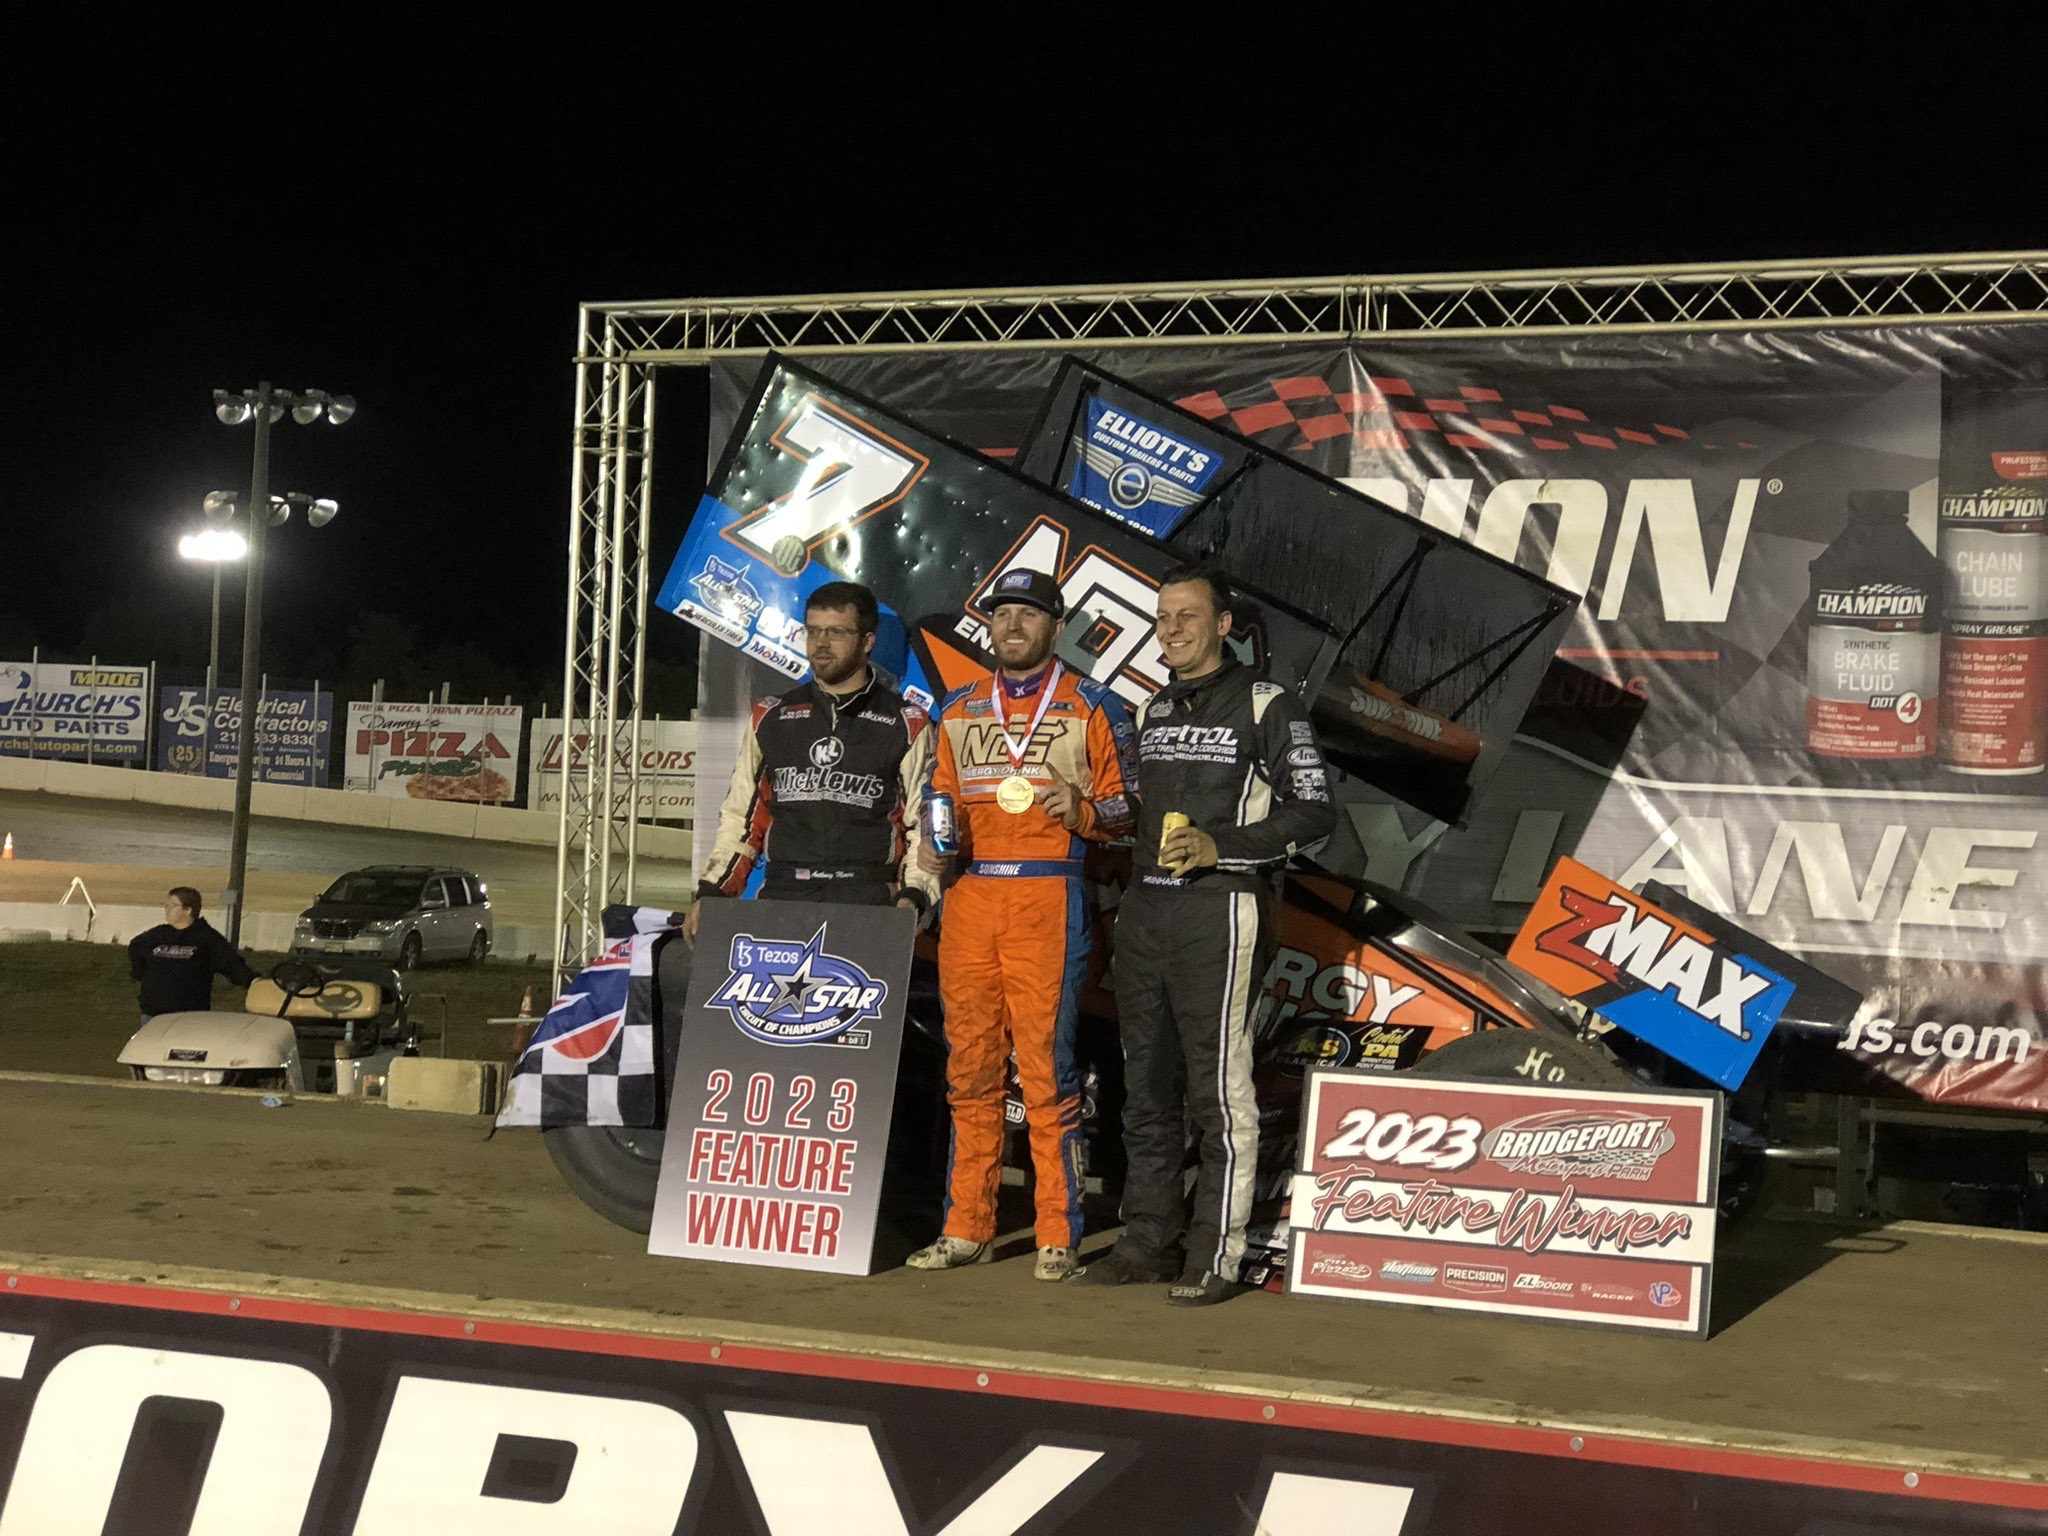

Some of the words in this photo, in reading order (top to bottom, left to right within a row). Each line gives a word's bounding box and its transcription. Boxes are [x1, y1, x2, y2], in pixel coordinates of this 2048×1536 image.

[1097, 410, 1210, 473] ELLIOTT'S
[1093, 431, 1126, 453] CUSTOM
[1123, 445, 1163, 469] TRAILERS
[1160, 463, 1168, 473] &
[1168, 465, 1197, 484] CARTS
[721, 392, 929, 574] 7
[1942, 498, 2047, 518] CHAMPION
[1337, 478, 1761, 622] ON
[1956, 552, 2022, 573] CHAIN
[1960, 577, 2016, 597] LUBE
[1817, 593, 1926, 615] CHAMPION
[953, 614, 997, 656] EN
[1984, 624, 2024, 635] GREASE
[750, 641, 787, 667] Mobil
[1843, 639, 1890, 650] SYNTHETIC
[1834, 652, 1900, 671] BRAKE
[73, 671, 142, 687] MOOG
[1837, 673, 1894, 692] FLUID
[0, 692, 141, 720] HURCH'S
[215, 696, 307, 715] Eletrical
[388, 704, 422, 713] PIZZA
[1870, 697, 1896, 708] DOT
[1899, 696, 1918, 718] 4
[54, 720, 130, 735] PARTS
[214, 713, 329, 732] Cotractors
[356, 729, 511, 759] PIZZA
[1139, 724, 1238, 746] CAPITOL
[175, 746, 195, 762] 25
[757, 946, 800, 965] Tezos
[1535, 884, 1773, 1042] ZMAX
[721, 973, 775, 1003] ALL
[804, 985, 880, 1014] STAR
[1263, 946, 1426, 1025] RGY
[738, 1005, 766, 1027] CIRCUIT
[764, 1022, 779, 1033] OF
[778, 1015, 841, 1036] CHAMPIONS
[1362, 1044, 1400, 1058] PA
[1322, 1108, 1484, 1171] 2023
[1489, 1118, 1666, 1158] BRIDGEPORT
[686, 1128, 858, 1196] FEATURE
[1606, 1164, 1654, 1181] PARK
[1312, 1163, 1501, 1233] Feature
[1496, 1183, 1692, 1253] Winner
[686, 1194, 844, 1260] WINNER
[1380, 1260, 1439, 1278] Hoffman
[1446, 1267, 1506, 1283] PRECISION
[1536, 1279, 1575, 1292] DOORS
[1651, 1281, 1672, 1305] VP
